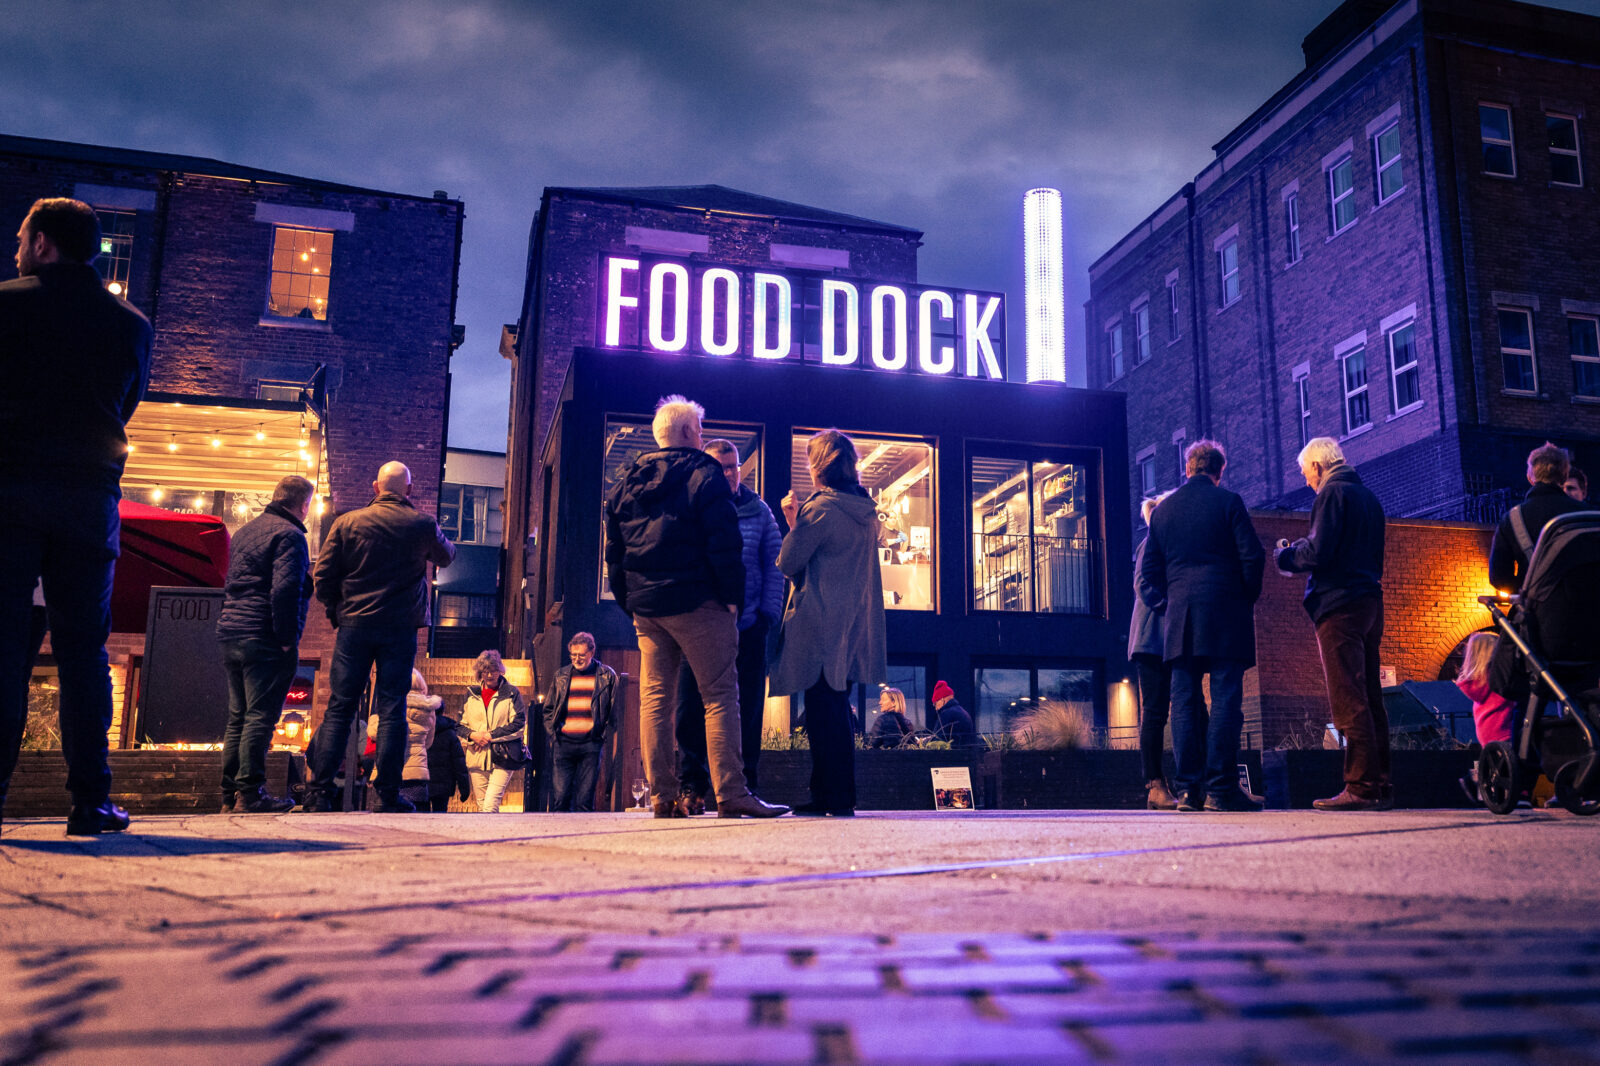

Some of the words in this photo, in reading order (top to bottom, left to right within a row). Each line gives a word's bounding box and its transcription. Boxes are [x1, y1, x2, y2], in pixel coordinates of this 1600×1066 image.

[605, 257, 792, 360] FOOD
[821, 279, 1003, 379] DOCK
[158, 598, 210, 621] FOOD
